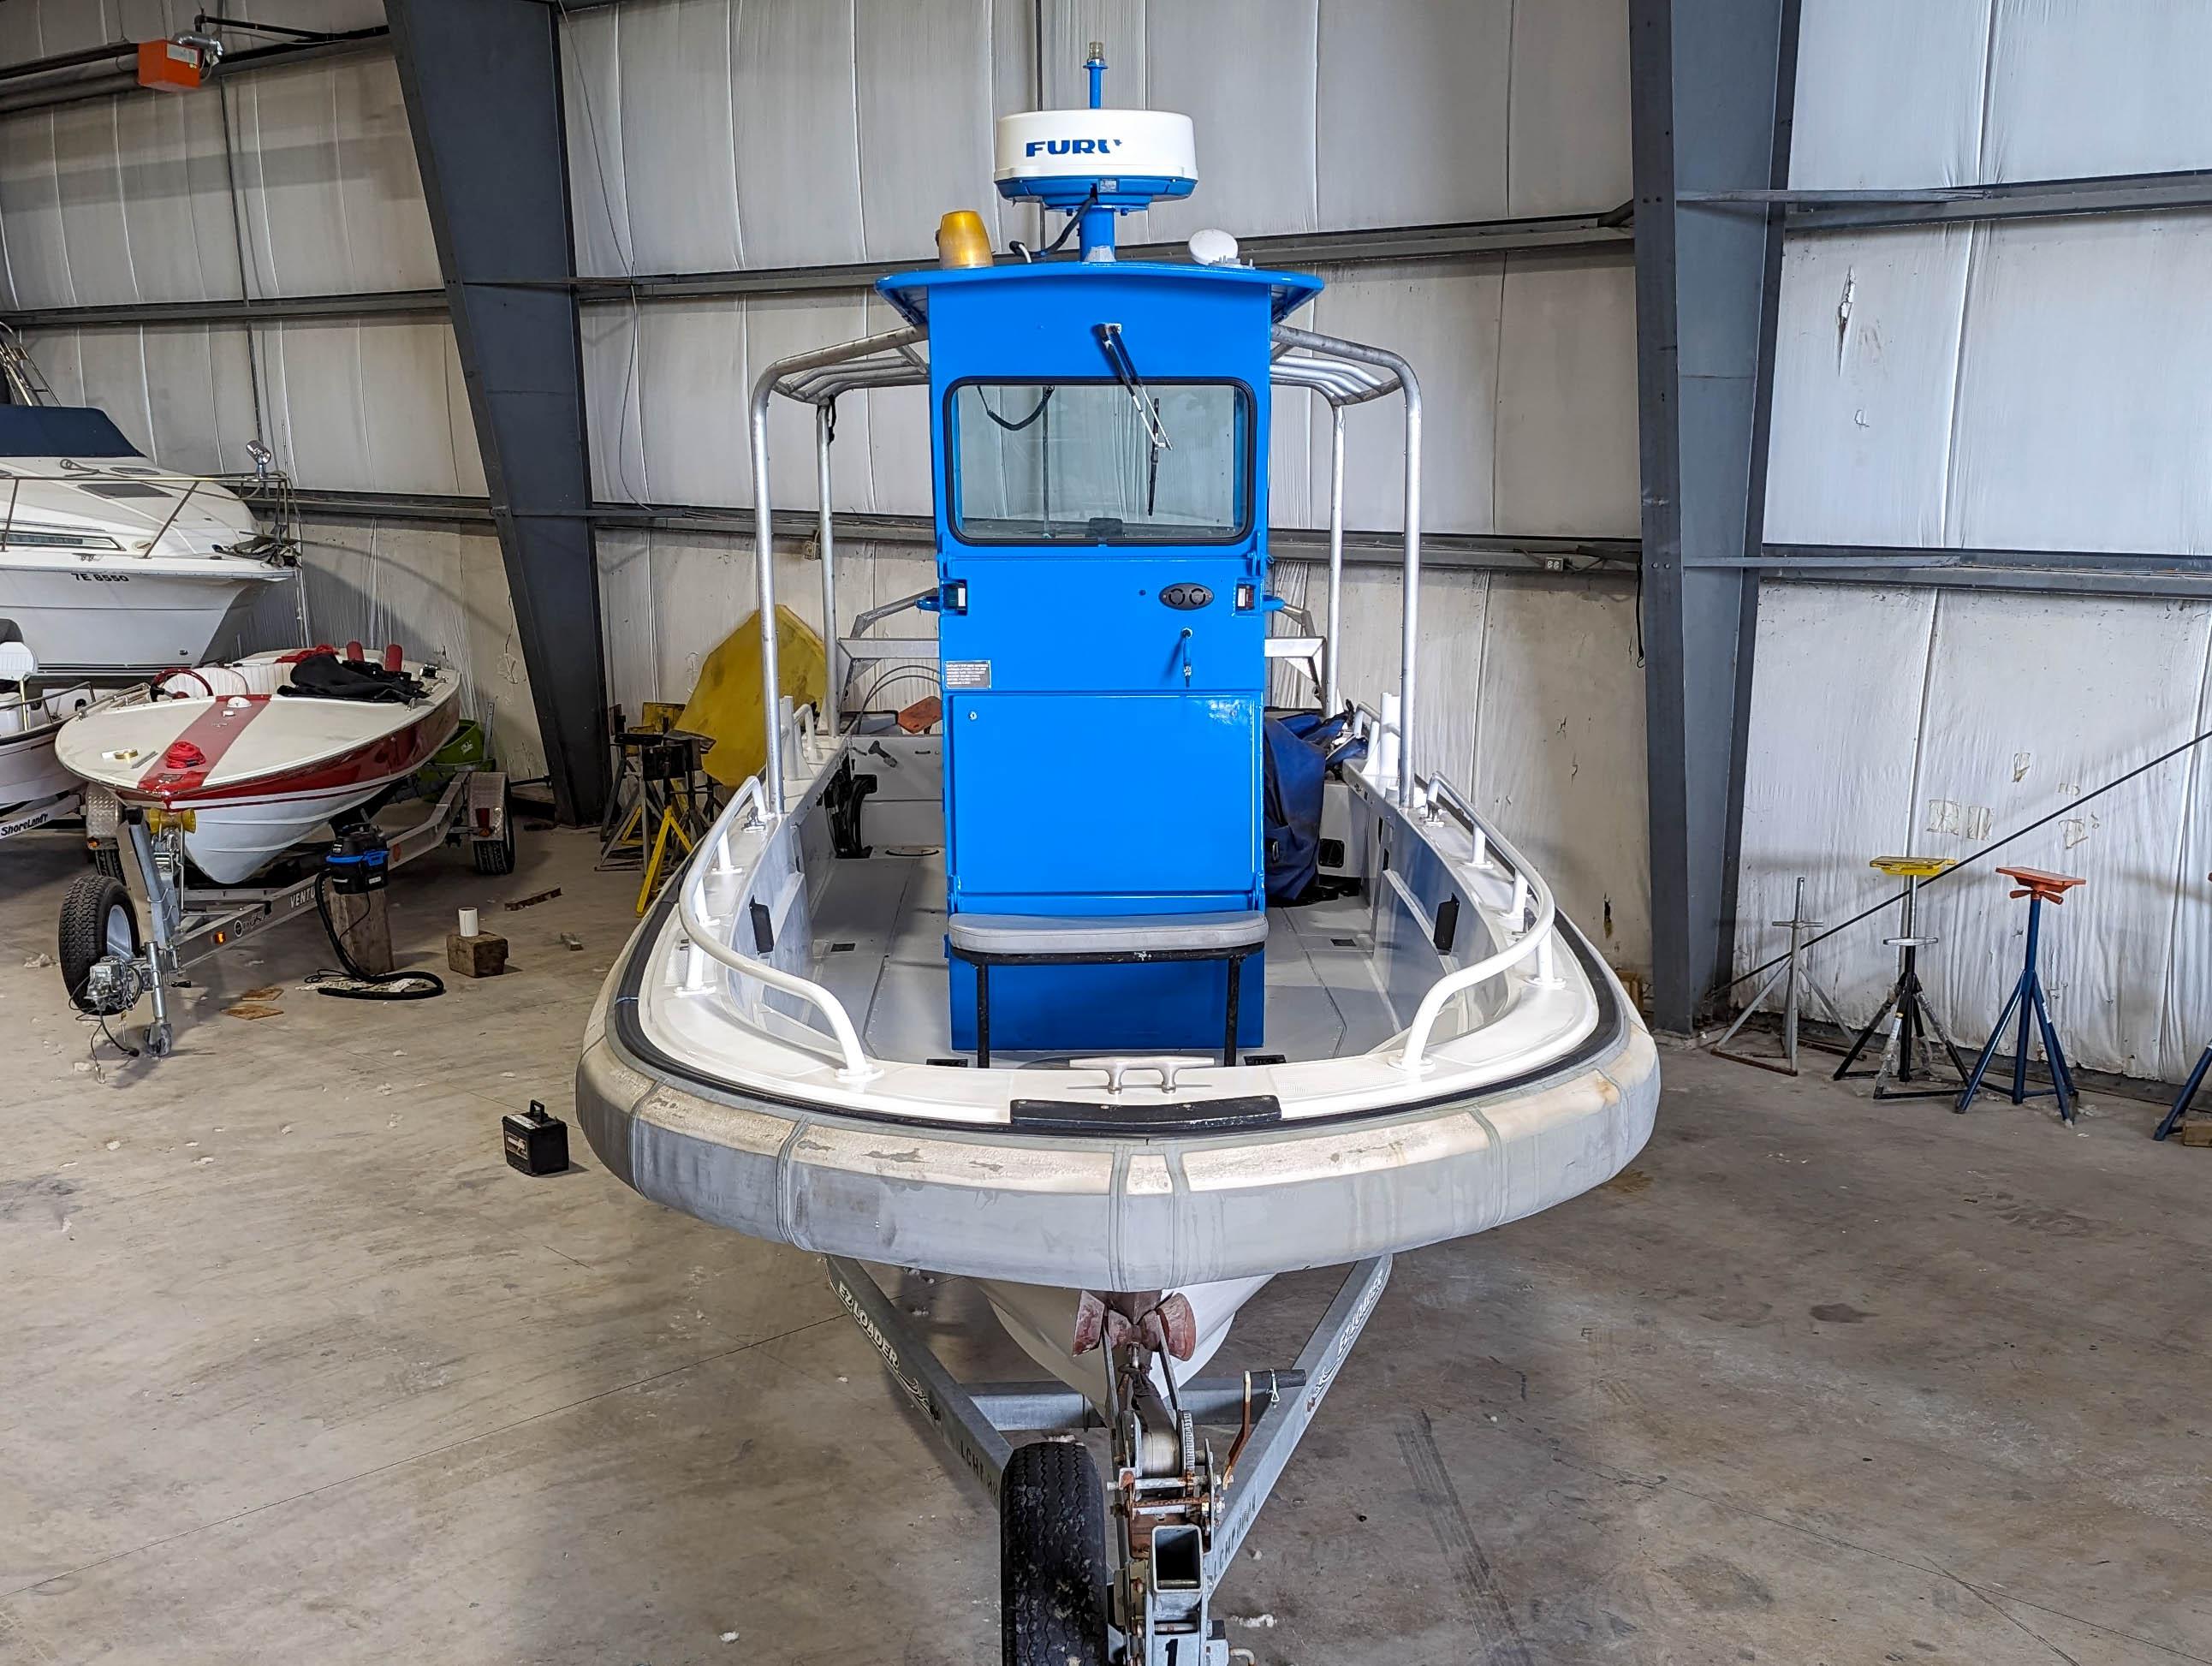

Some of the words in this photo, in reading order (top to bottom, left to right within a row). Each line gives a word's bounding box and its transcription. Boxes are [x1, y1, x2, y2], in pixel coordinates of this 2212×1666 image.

[70, 572, 92, 582] 7E
[288, 880, 326, 909] VENTU
[853, 1300, 900, 1369] LOADER
